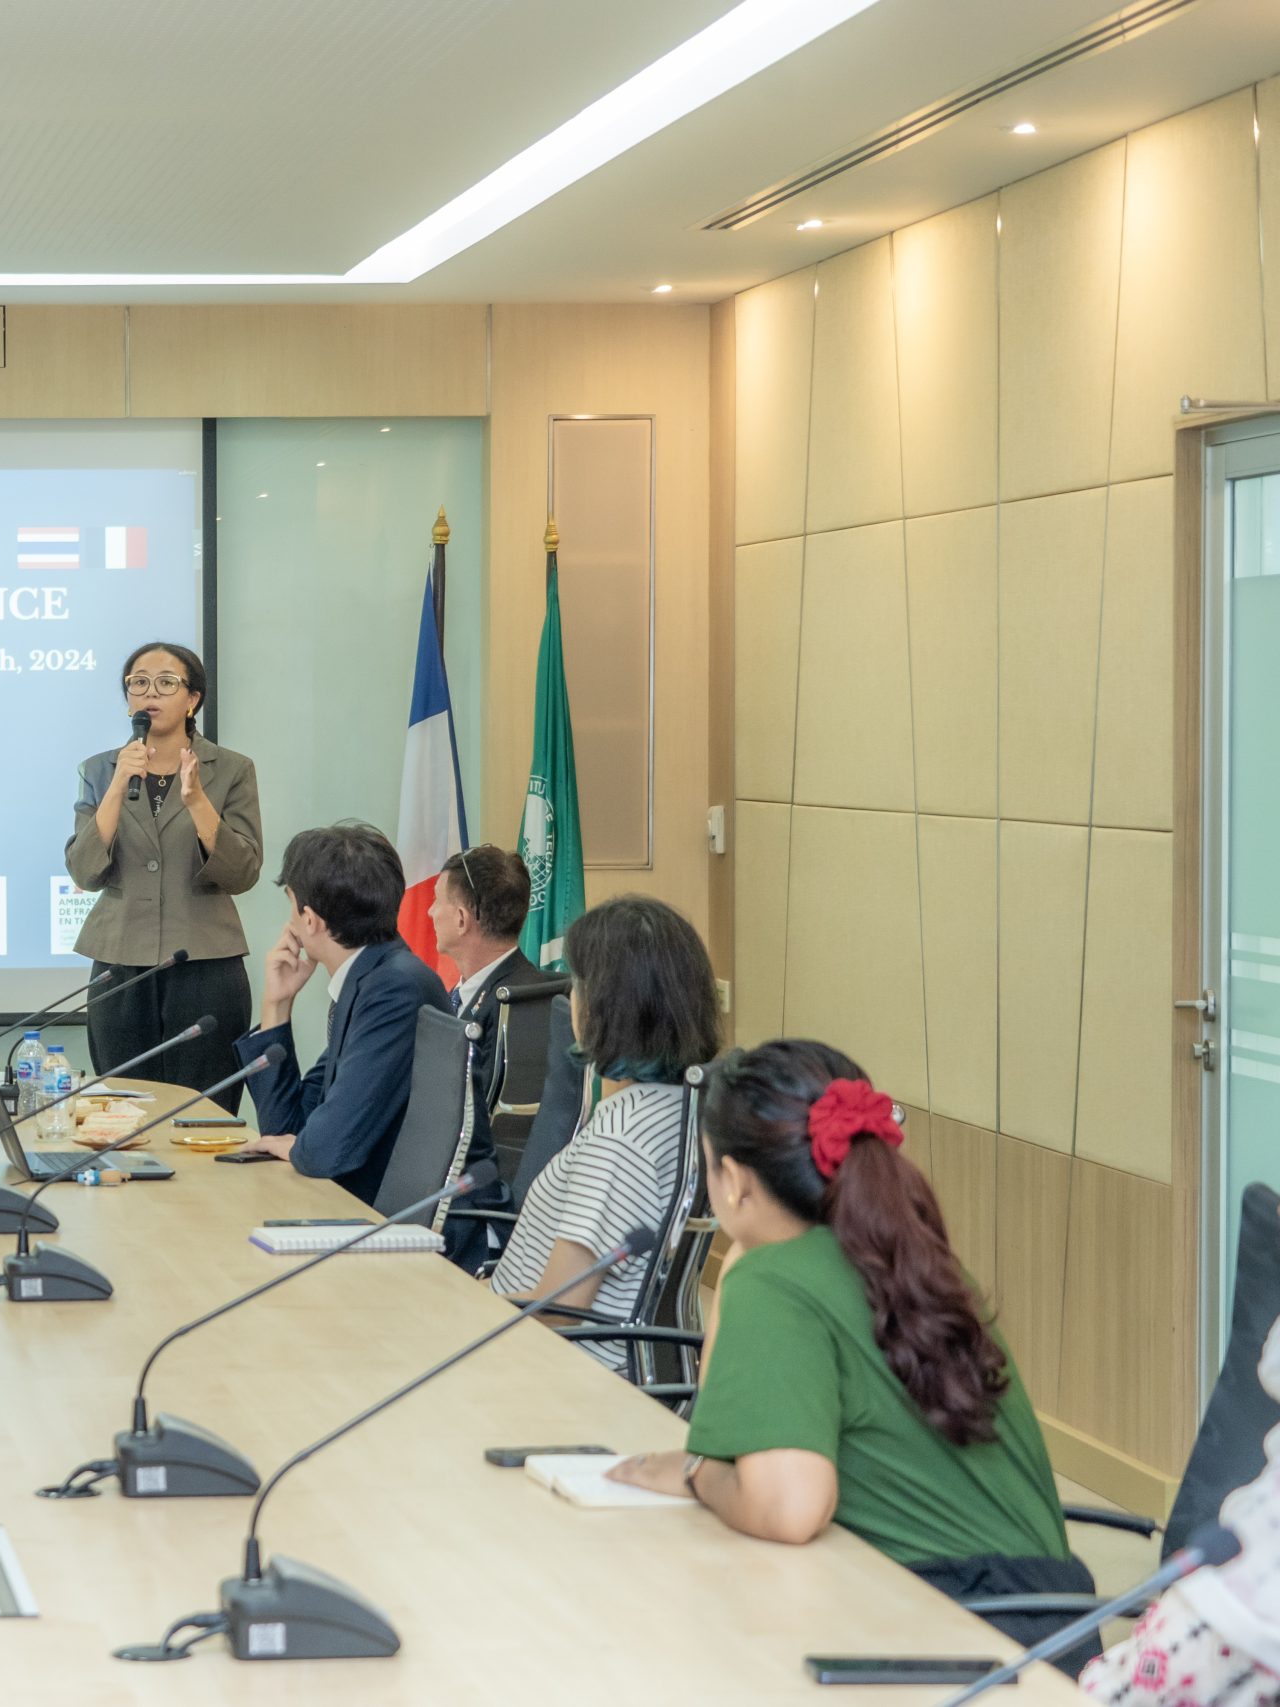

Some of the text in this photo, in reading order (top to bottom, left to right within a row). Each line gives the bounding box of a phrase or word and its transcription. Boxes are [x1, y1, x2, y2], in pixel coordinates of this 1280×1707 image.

[29, 648, 97, 672] 2024
[59, 907, 71, 916] DE
[59, 917, 72, 926] EN
